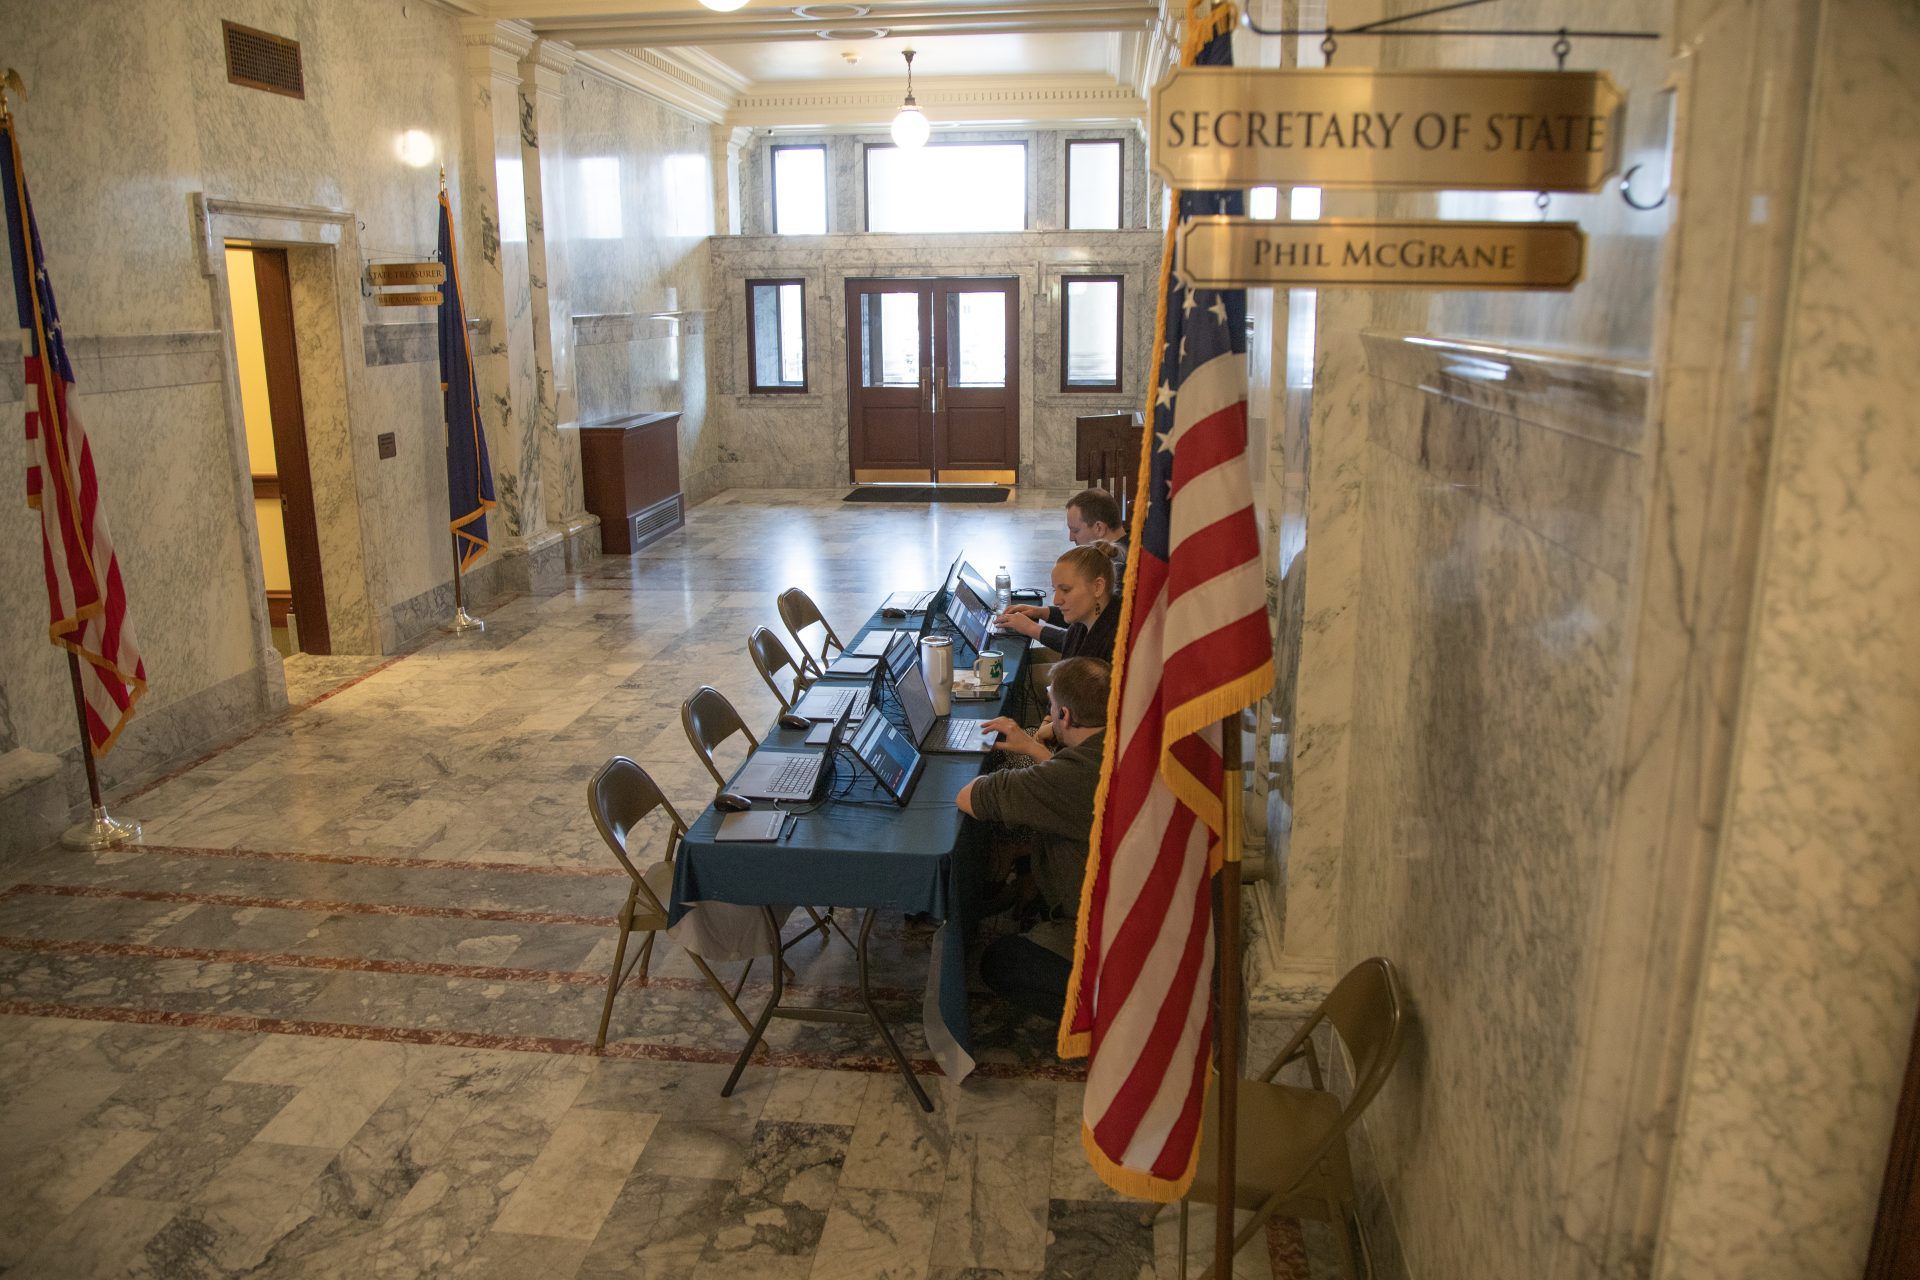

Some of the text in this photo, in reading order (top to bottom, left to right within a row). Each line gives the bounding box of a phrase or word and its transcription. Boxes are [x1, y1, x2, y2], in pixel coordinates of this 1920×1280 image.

[1167, 110, 1607, 153] SECRETARY OF STATE
[1253, 240, 1330, 268] PHIL
[368, 270, 442, 280] STATE TREASURER
